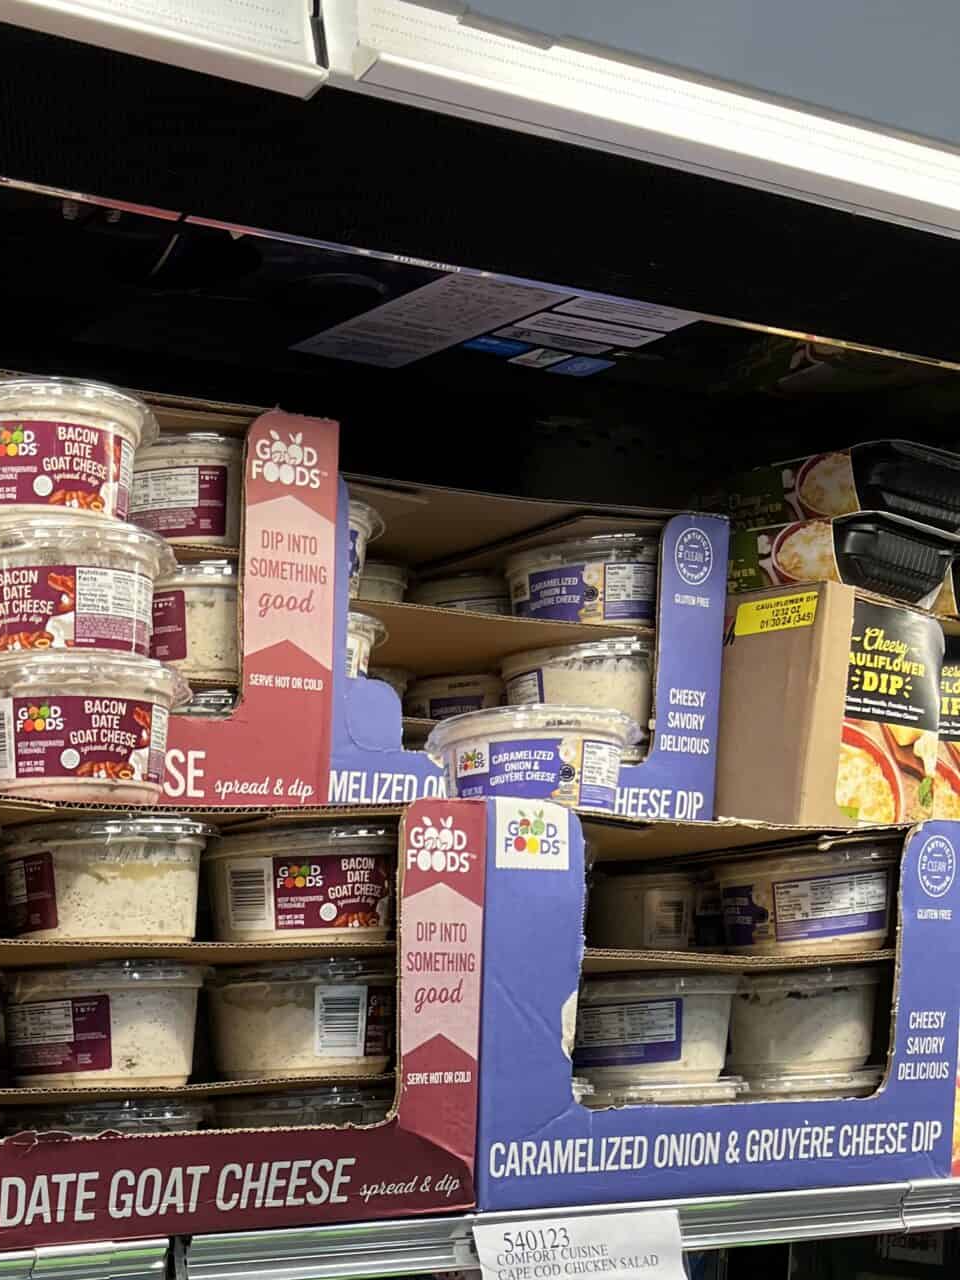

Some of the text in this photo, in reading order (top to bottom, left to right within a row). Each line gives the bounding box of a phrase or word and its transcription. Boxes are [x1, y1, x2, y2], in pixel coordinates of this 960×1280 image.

[261, 529, 318, 555] DIP INTO
[250, 558, 327, 585] SOMETHING
[3, 585, 32, 600] DATE
[12, 600, 54, 616] CHEESE
[259, 590, 315, 618] good
[864, 628, 908, 659] Cheesy
[862, 671, 904, 695] DIP
[84, 700, 127, 716] BACON
[669, 688, 705, 708] CHEESY
[668, 712, 705, 730] SAVORY
[660, 734, 709, 754] DELICIOUS
[492, 749, 554, 765] CARAMELIZED
[526, 771, 555, 783] CHEESE
[675, 789, 704, 819] DIP
[410, 827, 467, 850] GOOD
[407, 849, 470, 872] FOODS
[917, 910, 938, 920] GLUTEN
[416, 922, 467, 942] DIP INTO
[407, 953, 475, 973] SOMETHING
[415, 980, 463, 1013] good
[909, 1012, 946, 1029] CHEESY
[907, 1038, 945, 1055] SAVORY
[898, 1063, 949, 1081] DELICIOUS
[489, 1120, 942, 1179] CARAMELIZED ONION & GRUYÈRE CHEESE DIP
[108, 1165, 211, 1222] GOAT
[217, 1158, 357, 1214] CHEESE
[359, 1177, 416, 1205] spread
[419, 1176, 433, 1194] &
[434, 1174, 460, 1198] dip
[503, 1227, 570, 1252] 540123
[497, 1244, 608, 1266] COMFORT CUISINE
[534, 1263, 561, 1277] COD
[565, 1257, 617, 1275] CHICKEN
[619, 1254, 658, 1267] SALAD
